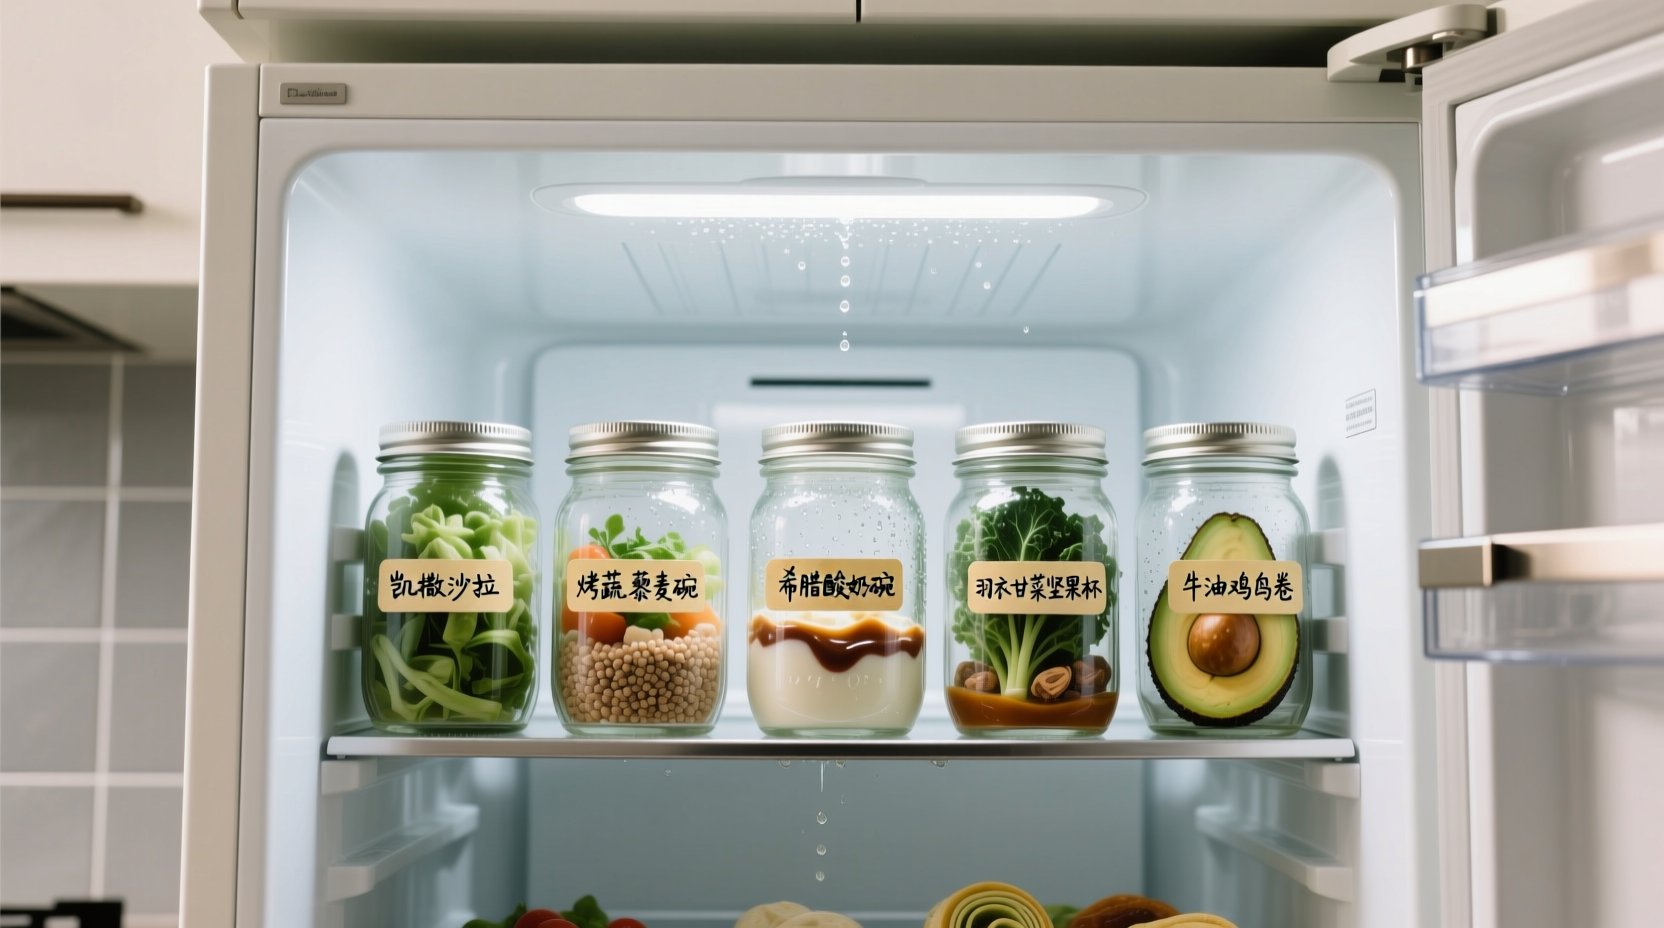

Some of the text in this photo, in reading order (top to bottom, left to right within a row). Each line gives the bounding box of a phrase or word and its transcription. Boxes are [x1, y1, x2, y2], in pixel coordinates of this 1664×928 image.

[778, 565, 896, 603] 希腊酸奶碗
